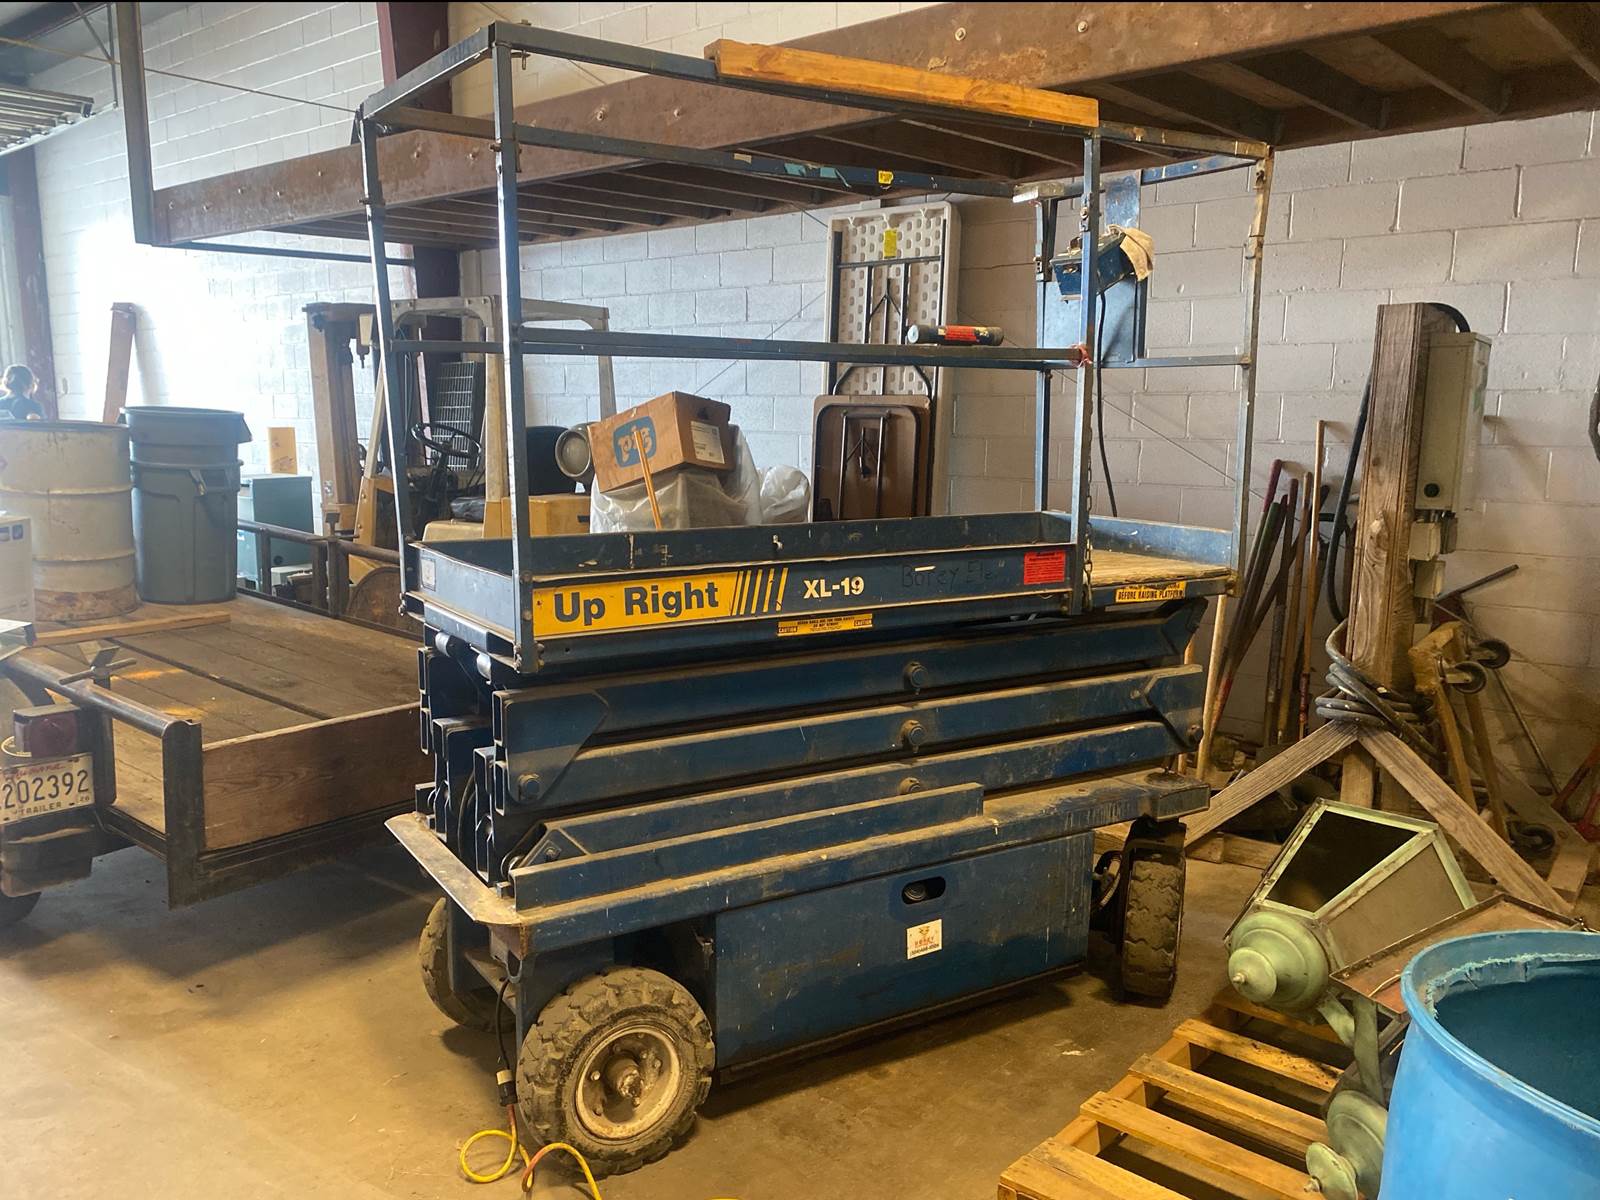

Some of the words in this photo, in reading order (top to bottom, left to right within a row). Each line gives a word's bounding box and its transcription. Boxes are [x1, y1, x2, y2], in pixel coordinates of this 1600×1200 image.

[803, 576, 865, 599] XL-19
[1118, 590, 1136, 600] BEFORE
[1138, 590, 1158, 600] RAISING
[554, 591, 606, 626] Up
[624, 582, 719, 617] Right
[0, 769, 89, 809] 202392
[18, 801, 62, 815] TRAILER
